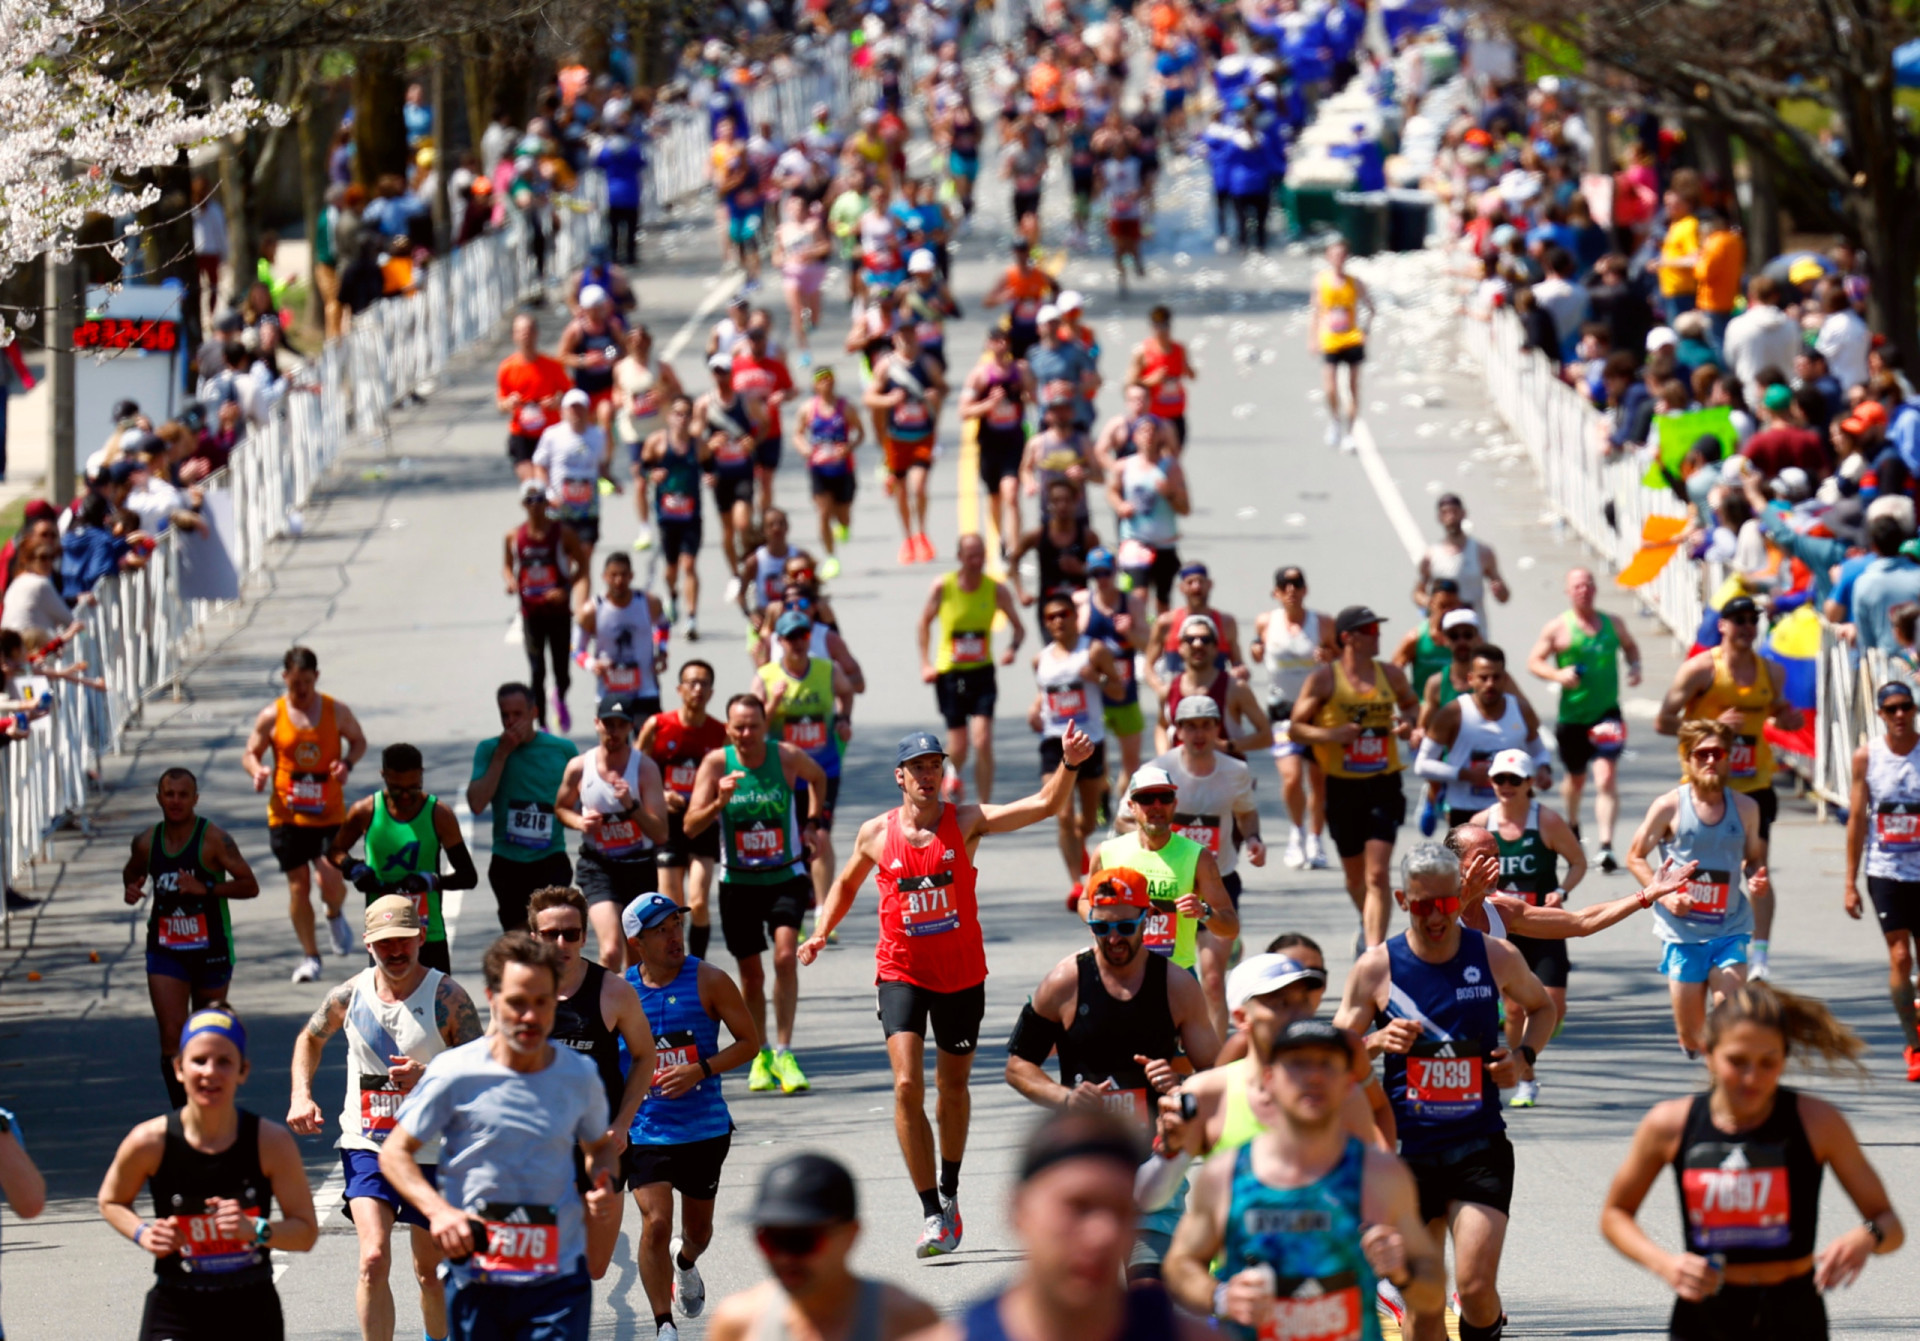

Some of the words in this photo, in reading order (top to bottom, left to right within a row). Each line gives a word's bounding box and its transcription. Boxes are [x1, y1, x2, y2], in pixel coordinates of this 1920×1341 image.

[515, 811, 547, 834] 9216
[908, 889, 948, 915] 8171
[164, 917, 200, 937] 7406
[1456, 986, 1492, 1001] BOSTON
[656, 1049, 690, 1071] 794
[1419, 1060, 1471, 1089] 7939
